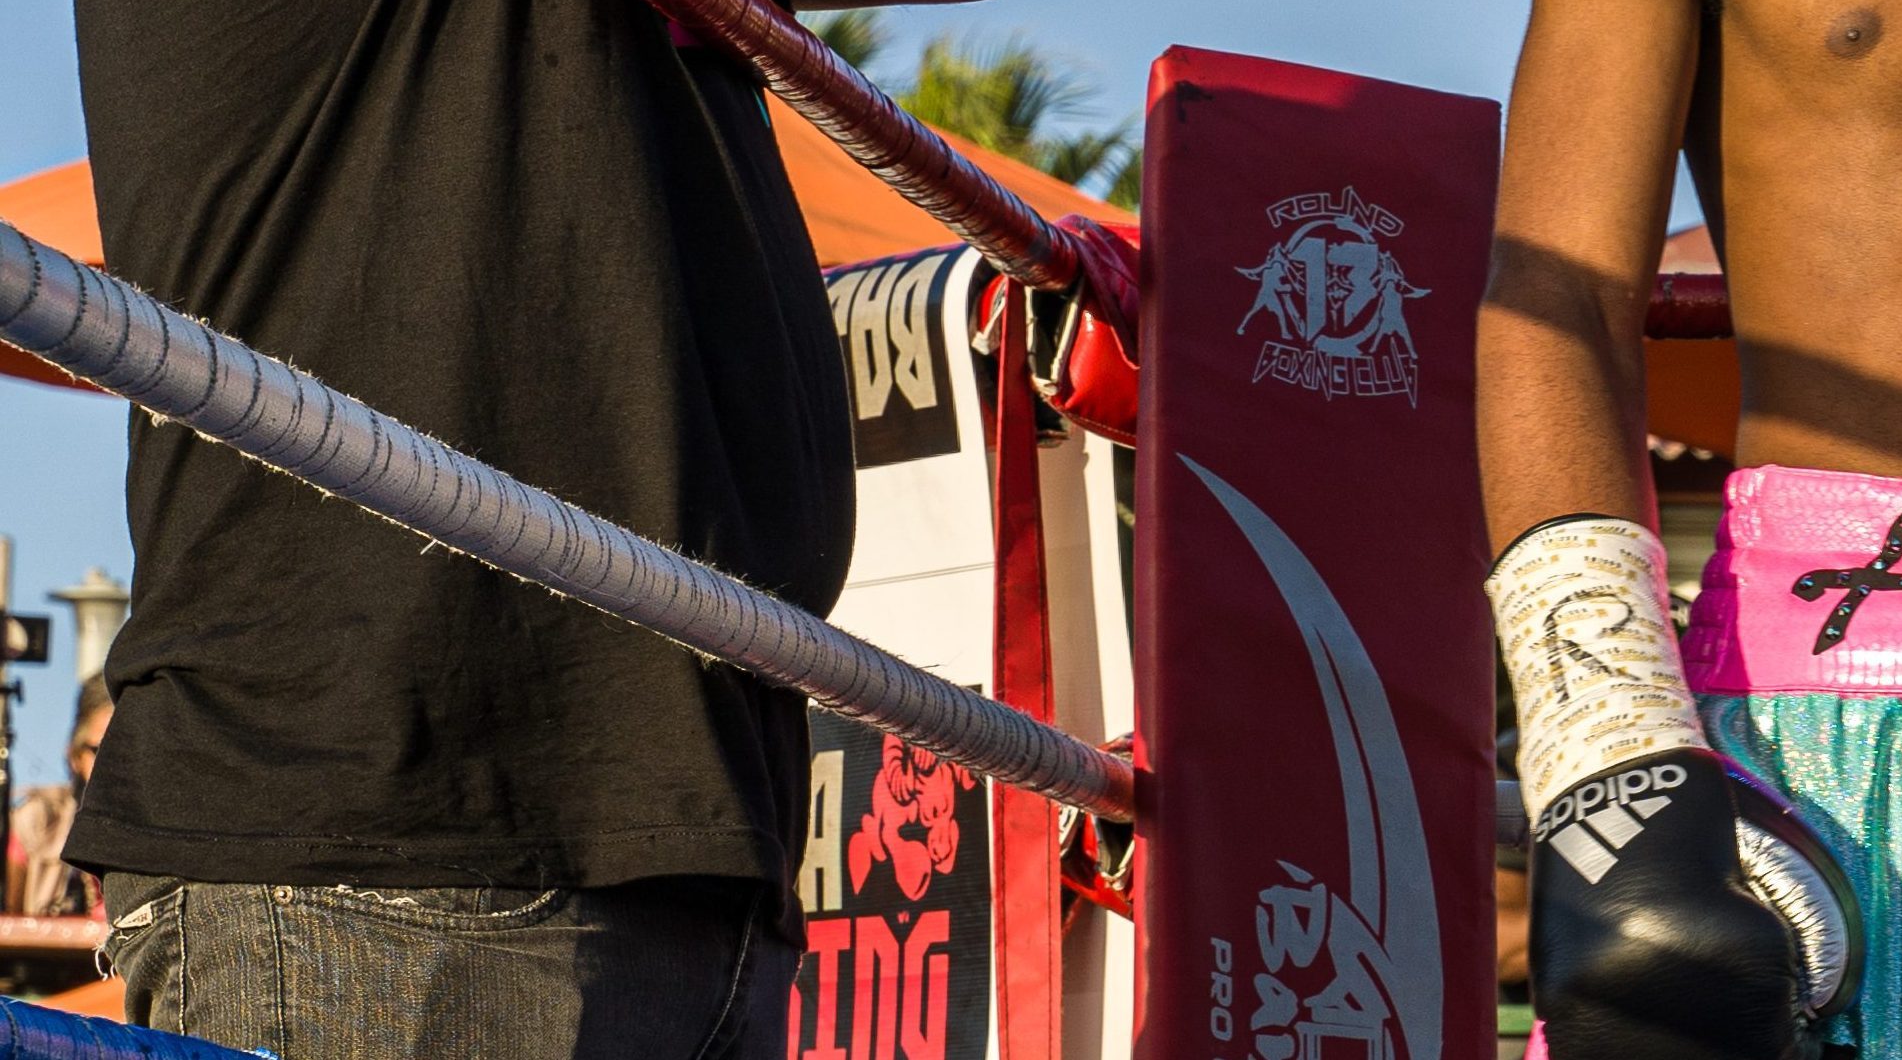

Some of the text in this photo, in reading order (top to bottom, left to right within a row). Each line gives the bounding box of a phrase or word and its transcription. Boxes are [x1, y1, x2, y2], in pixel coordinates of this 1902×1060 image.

[1266, 185, 1405, 237] ROUND
[1288, 237, 1379, 341] 13
[1253, 337, 1418, 409] BOXING CLUB
[1536, 764, 1688, 843] adidas
[788, 910, 949, 1060] ING
[1210, 937, 1233, 1042] PRO
